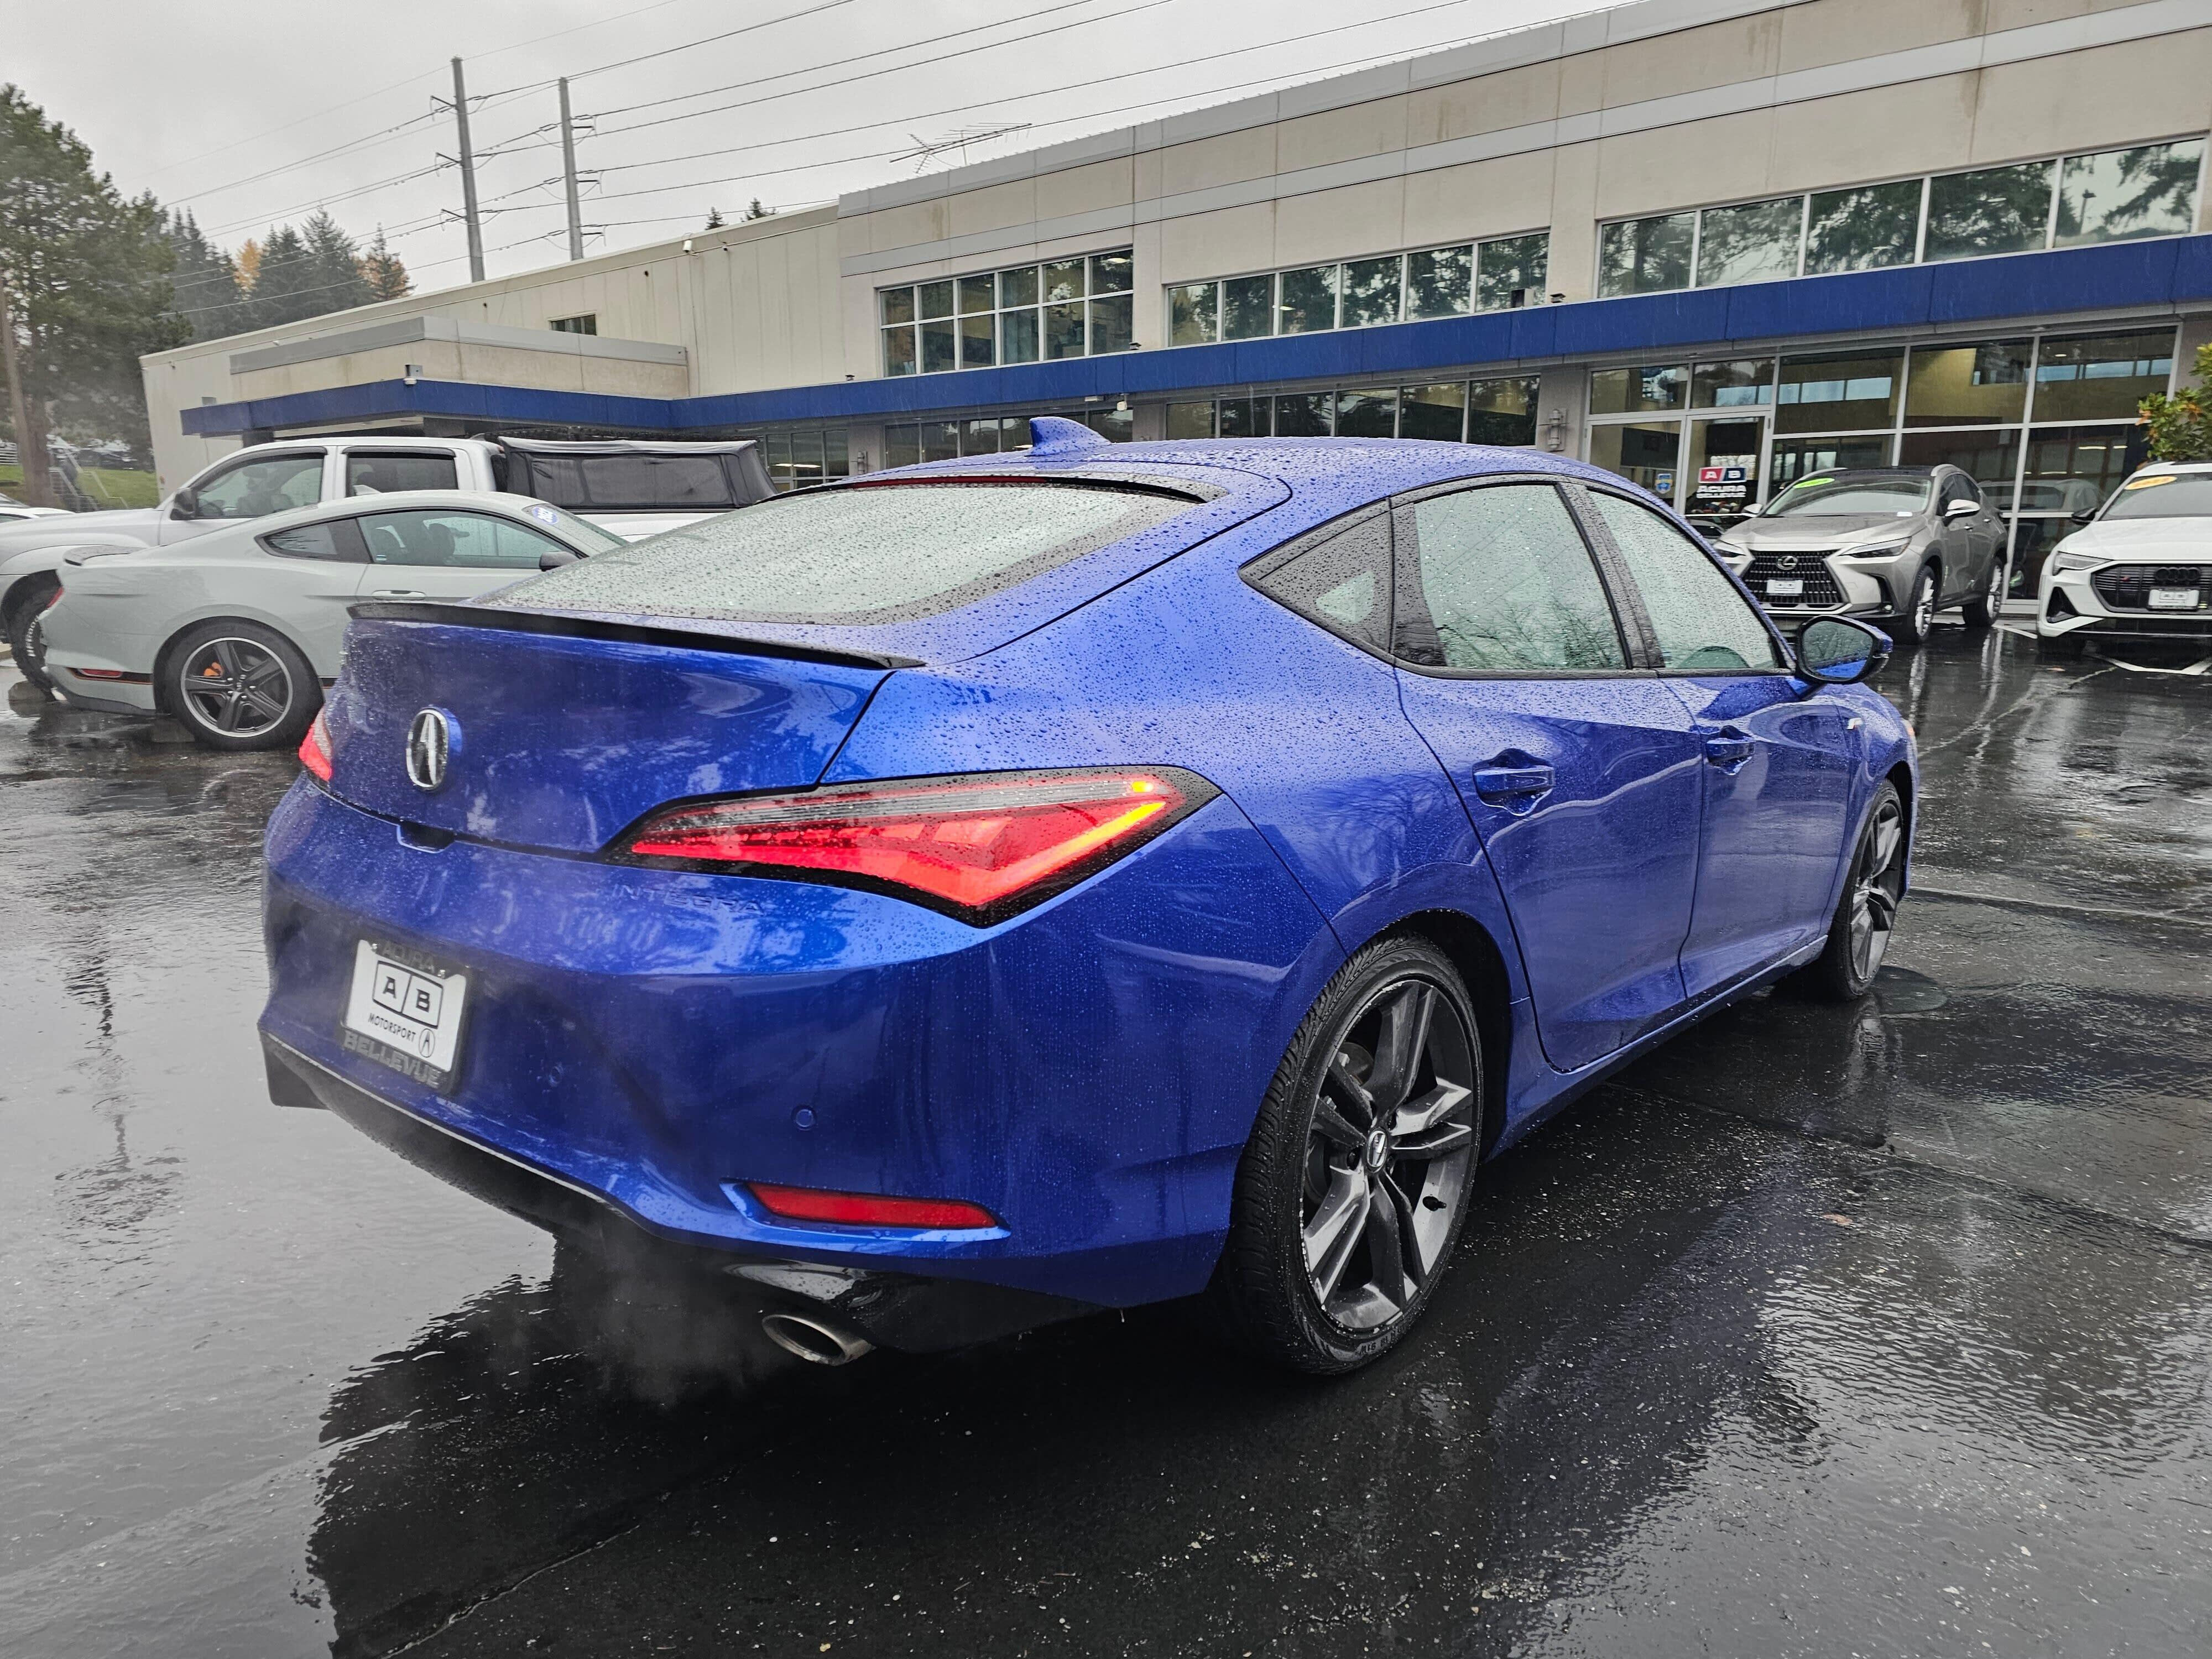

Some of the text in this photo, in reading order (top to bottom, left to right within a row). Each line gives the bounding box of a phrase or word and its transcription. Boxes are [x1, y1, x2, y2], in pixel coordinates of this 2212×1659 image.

[612, 884, 765, 916] INTEGRA
[383, 977, 430, 1012] A B
[368, 1013, 416, 1042] MOTORSPORT
[343, 1031, 442, 1088] BELLEVUE
